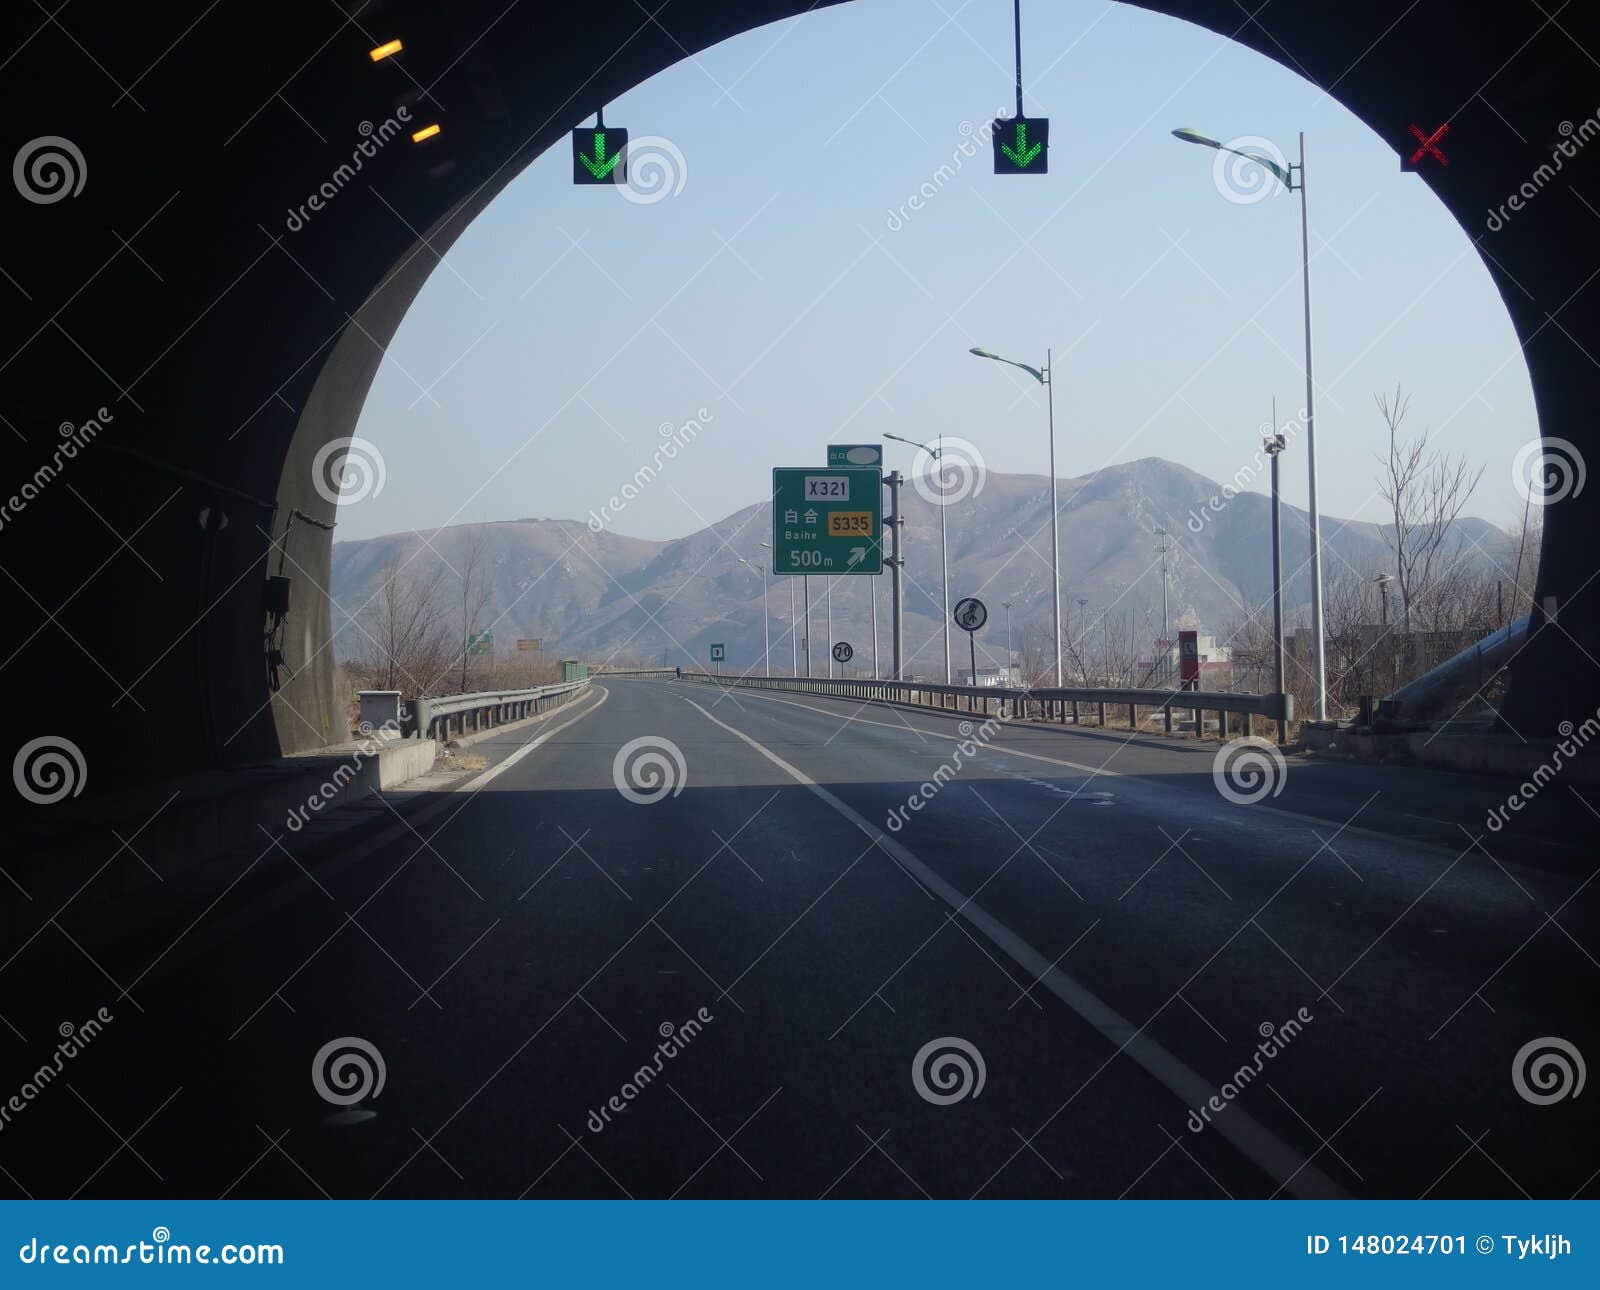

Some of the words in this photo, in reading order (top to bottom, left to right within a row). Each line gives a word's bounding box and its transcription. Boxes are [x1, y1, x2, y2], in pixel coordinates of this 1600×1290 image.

[809, 481, 846, 495] X321
[832, 516, 869, 530] S335
[785, 530, 817, 540] Baihe
[836, 647, 850, 657] 70
